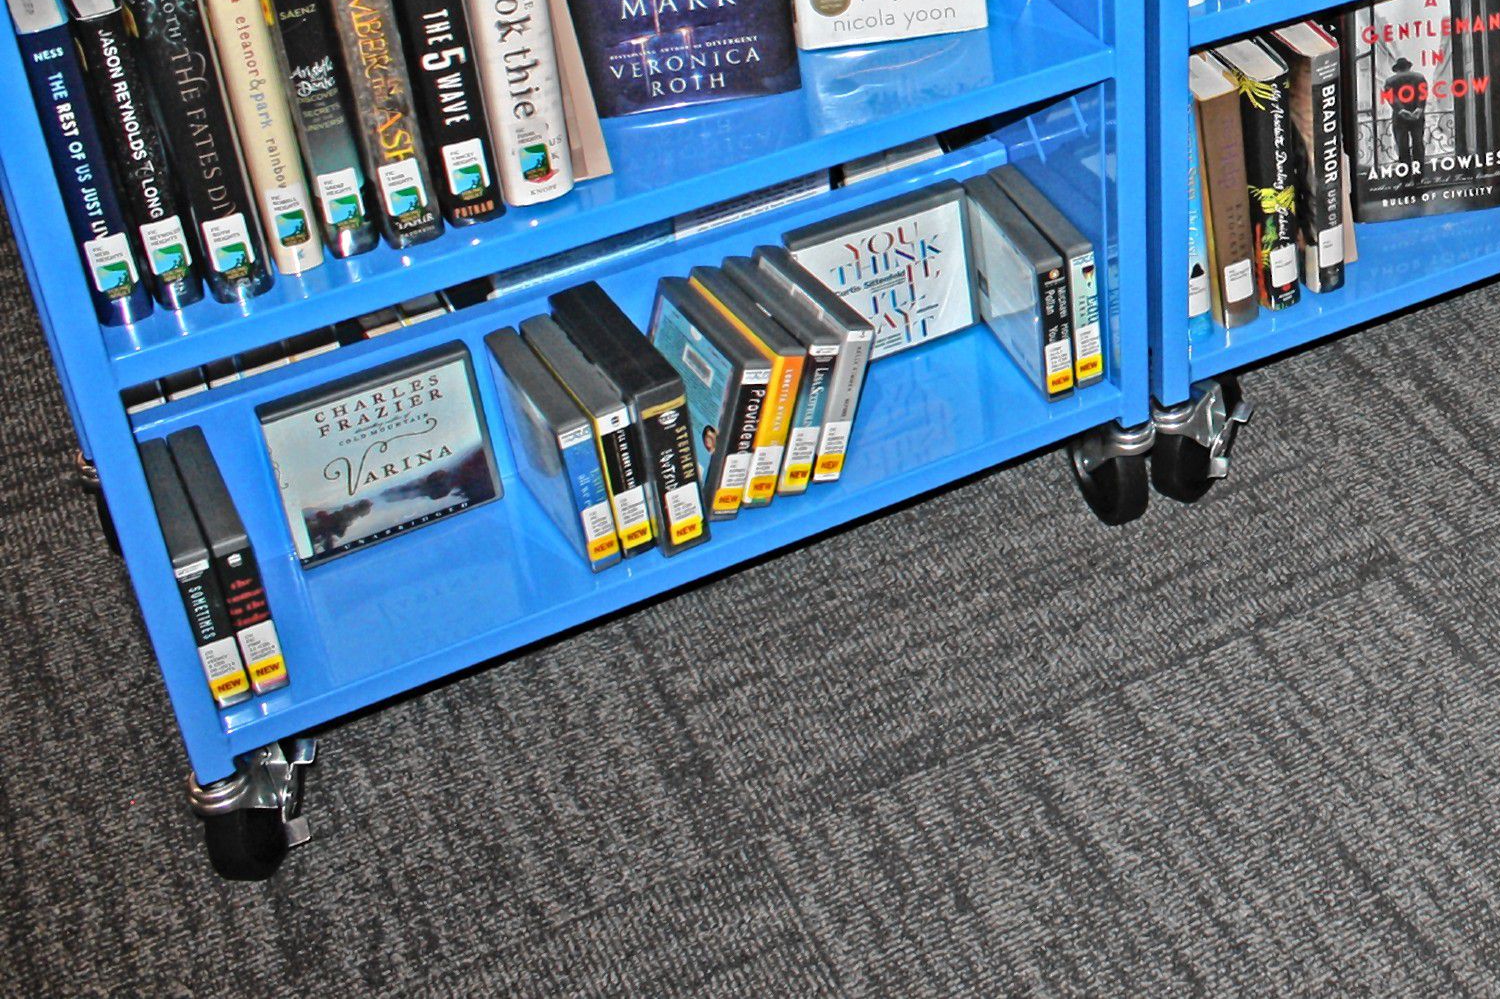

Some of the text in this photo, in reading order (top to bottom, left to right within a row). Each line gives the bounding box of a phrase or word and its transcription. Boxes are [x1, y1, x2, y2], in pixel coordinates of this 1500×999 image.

[280, 3, 316, 21] SAENZ
[833, 5, 956, 33] nicola yoon
[33, 46, 64, 63] NESS
[610, 46, 760, 79] VERONICA
[1420, 50, 1445, 67] IN
[652, 73, 726, 97] ROTH
[1380, 76, 1490, 105] MOSCOW
[98, 28, 147, 173] JASON REYNOLDS
[1322, 84, 1336, 133] BRAD
[1323, 136, 1338, 184] THOR
[1368, 161, 1421, 181] AMOR
[1382, 186, 1494, 208] RULES OF CIVILITY
[313, 374, 440, 424] CHARLES
[318, 387, 444, 438] FRAZIER
[627, 528, 647, 541] NEW
[676, 523, 696, 536] NEW
[594, 540, 614, 553] NEW
[255, 662, 280, 677] NEW
[217, 678, 241, 693] NEW
